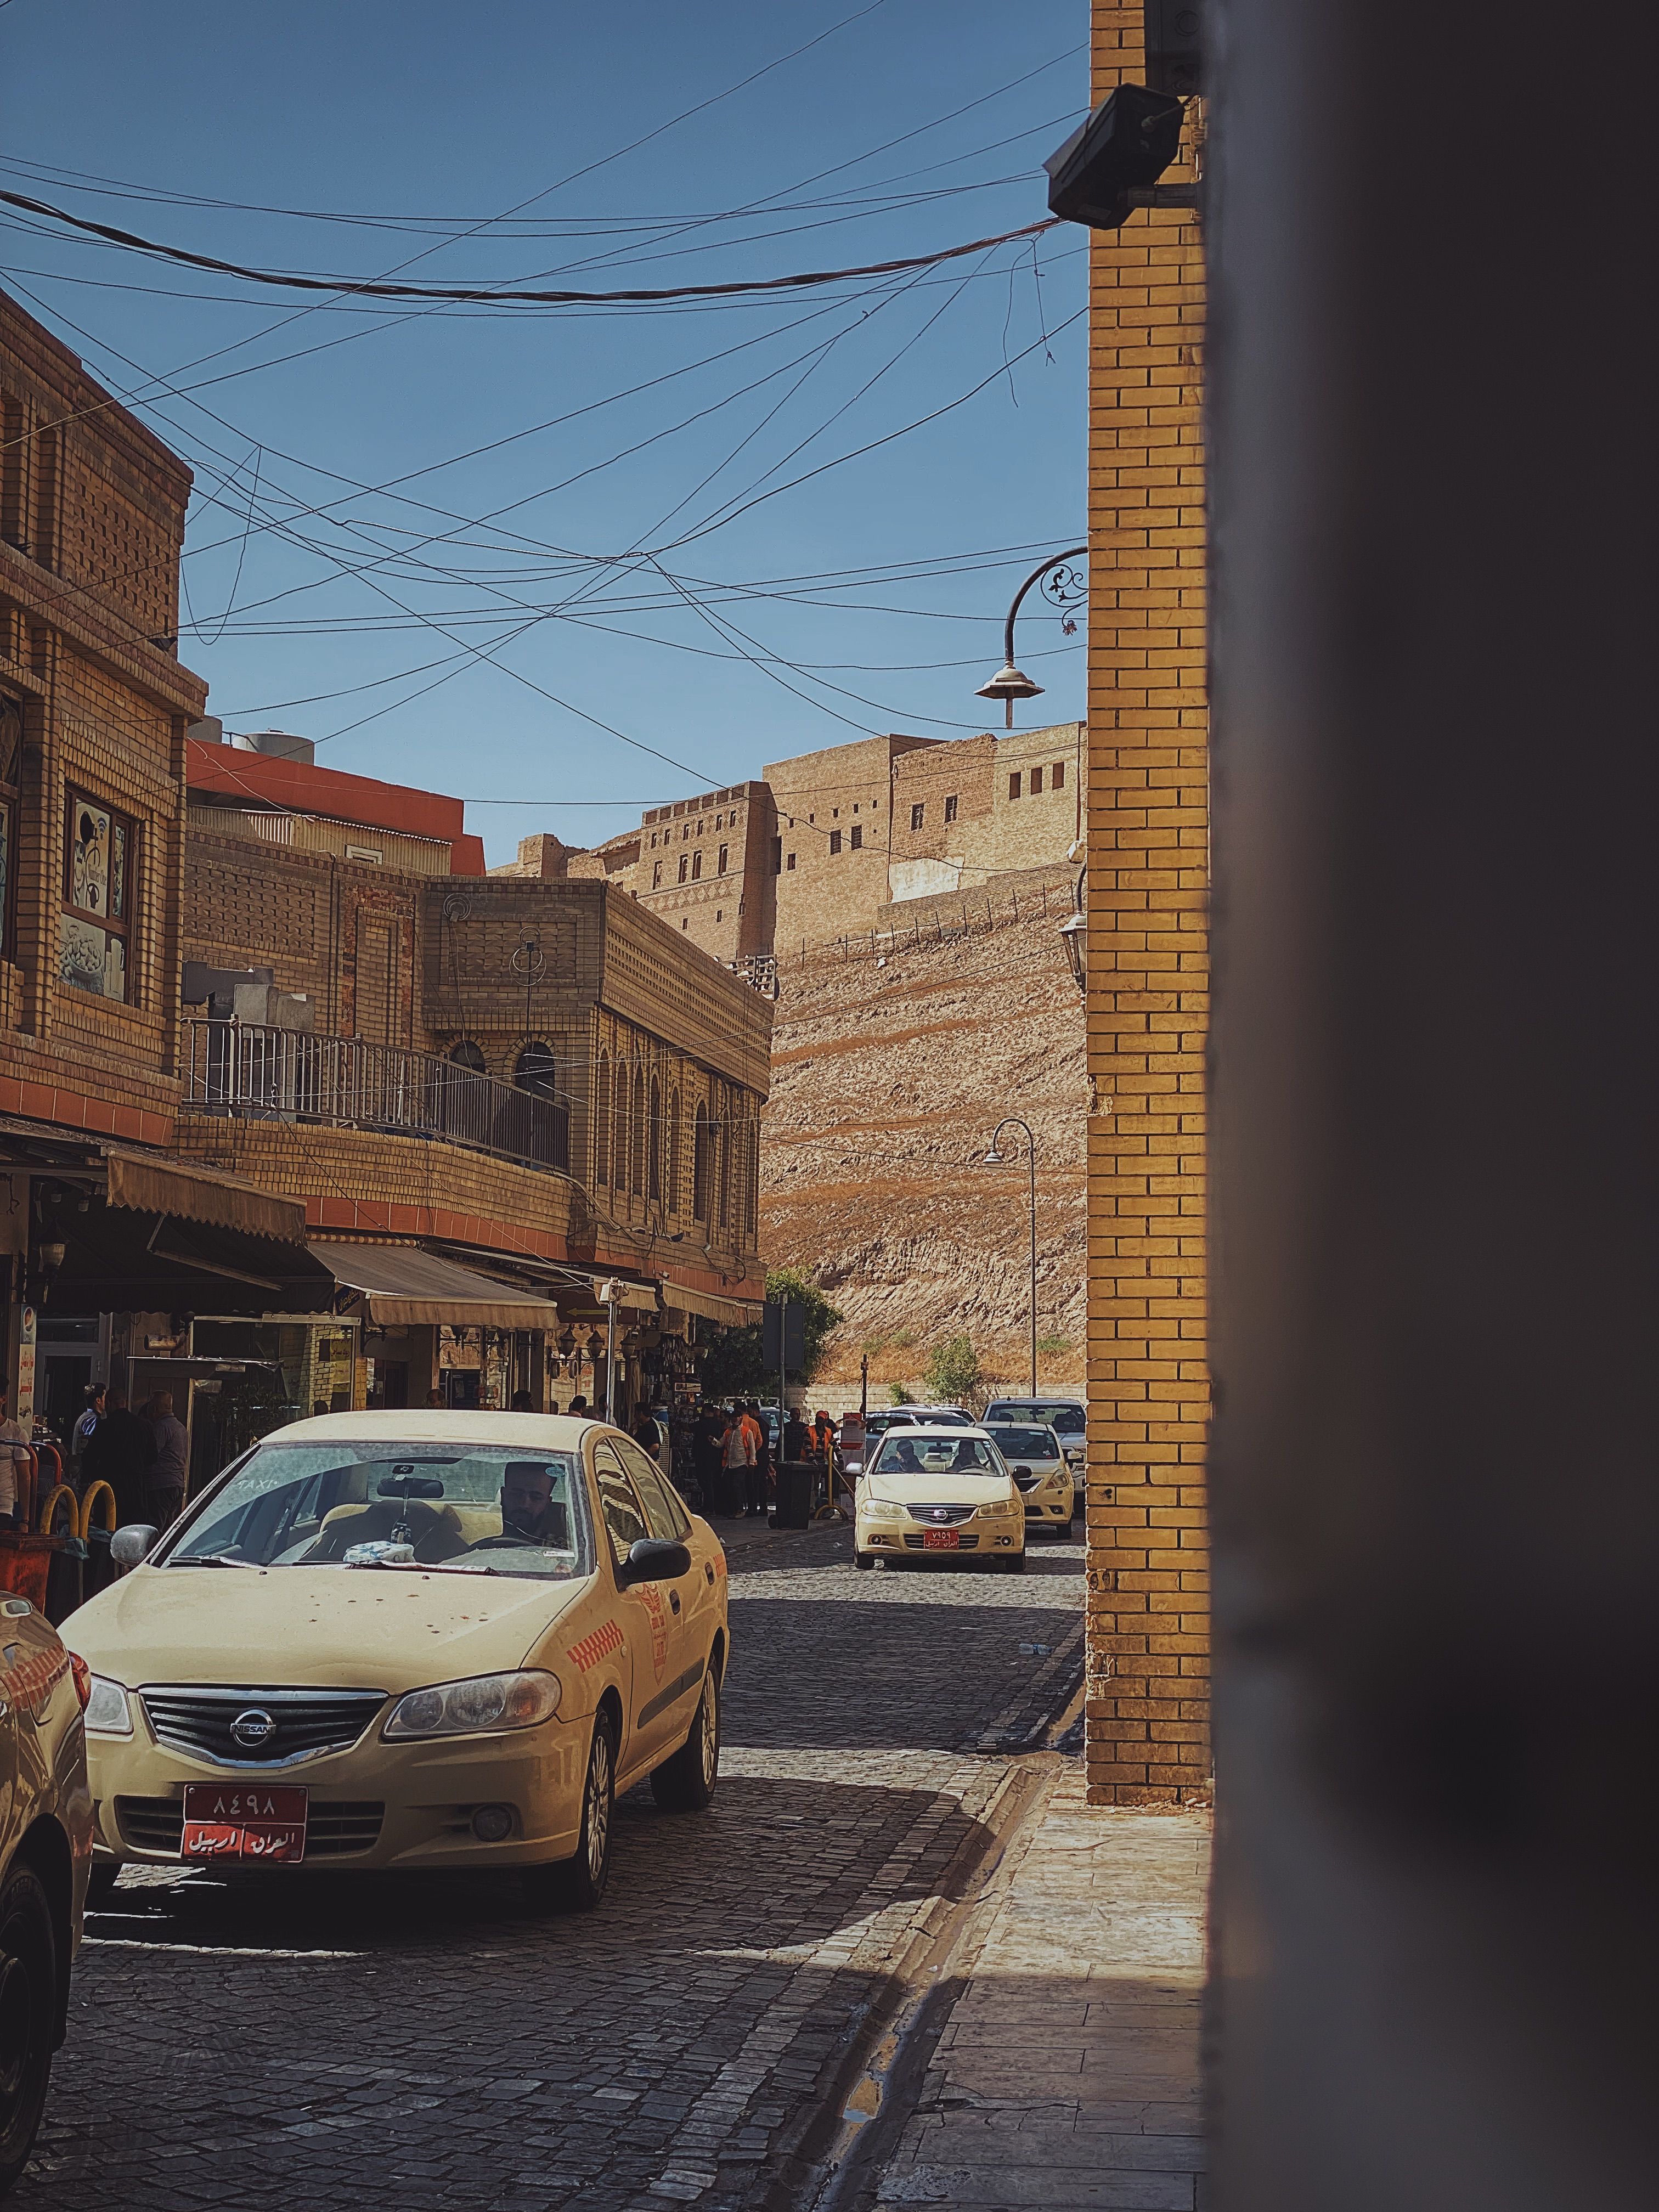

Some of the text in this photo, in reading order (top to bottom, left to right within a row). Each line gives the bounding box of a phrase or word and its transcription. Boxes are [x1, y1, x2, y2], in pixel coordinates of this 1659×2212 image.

[237, 1479, 276, 1489] TAXI
[213, 1795, 275, 1815] ٨٤٩٨
[189, 1831, 295, 1854] العراق اربيل
